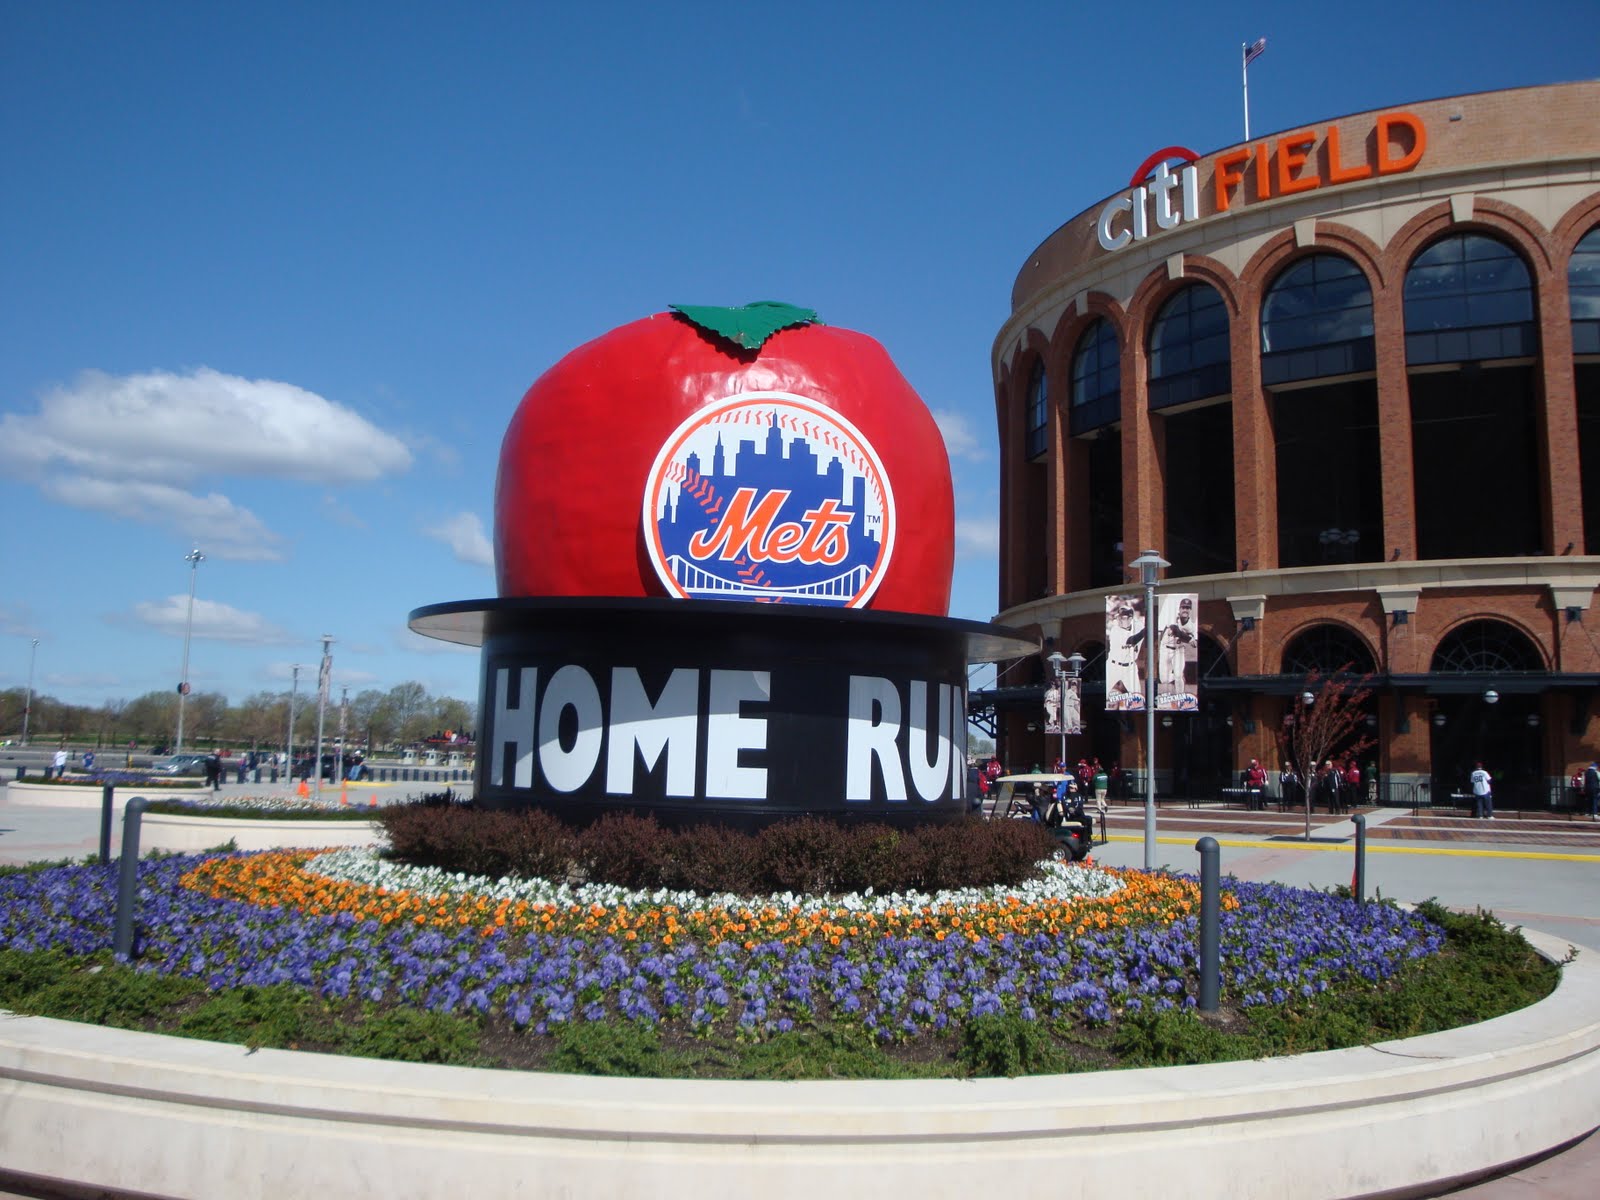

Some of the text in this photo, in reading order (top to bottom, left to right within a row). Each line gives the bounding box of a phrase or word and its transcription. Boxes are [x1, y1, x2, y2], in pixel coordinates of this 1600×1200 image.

[1097, 111, 1427, 251] citi FIELD
[689, 487, 855, 565] Mets
[866, 514, 881, 524] TM
[491, 664, 772, 799] HOME
[1159, 692, 1186, 704] BACKMAN
